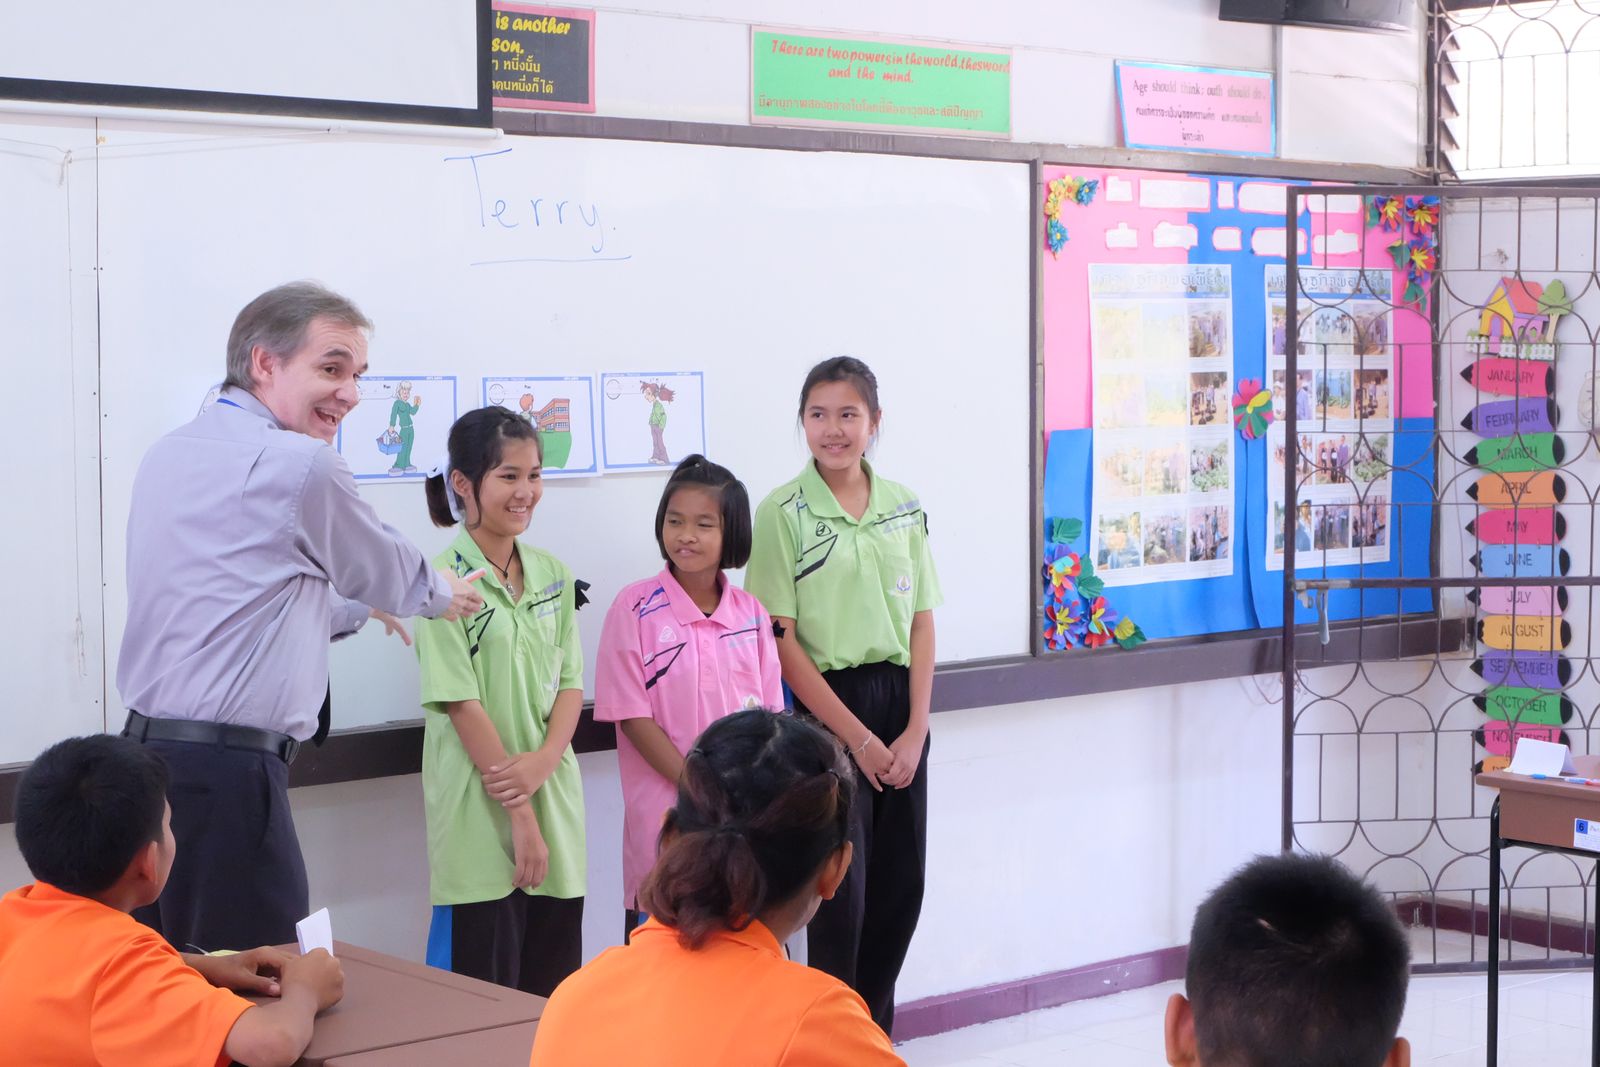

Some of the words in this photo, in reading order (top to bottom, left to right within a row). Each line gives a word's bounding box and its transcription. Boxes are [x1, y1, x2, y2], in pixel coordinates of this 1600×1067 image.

[496, 11, 509, 30] is
[512, 16, 570, 35] another
[772, 39, 803, 56] There
[806, 46, 825, 57] are
[829, 64, 851, 78] and
[857, 66, 875, 80] the
[1132, 79, 1148, 97] Age
[1152, 79, 1177, 94] should
[1496, 446, 1538, 461] MARCH
[1505, 553, 1533, 567] JUNE
[1506, 590, 1532, 604] JULY
[1500, 624, 1545, 638] AUGUST
[1496, 695, 1547, 713] OCTOBER
[1579, 822, 1585, 832] 6
